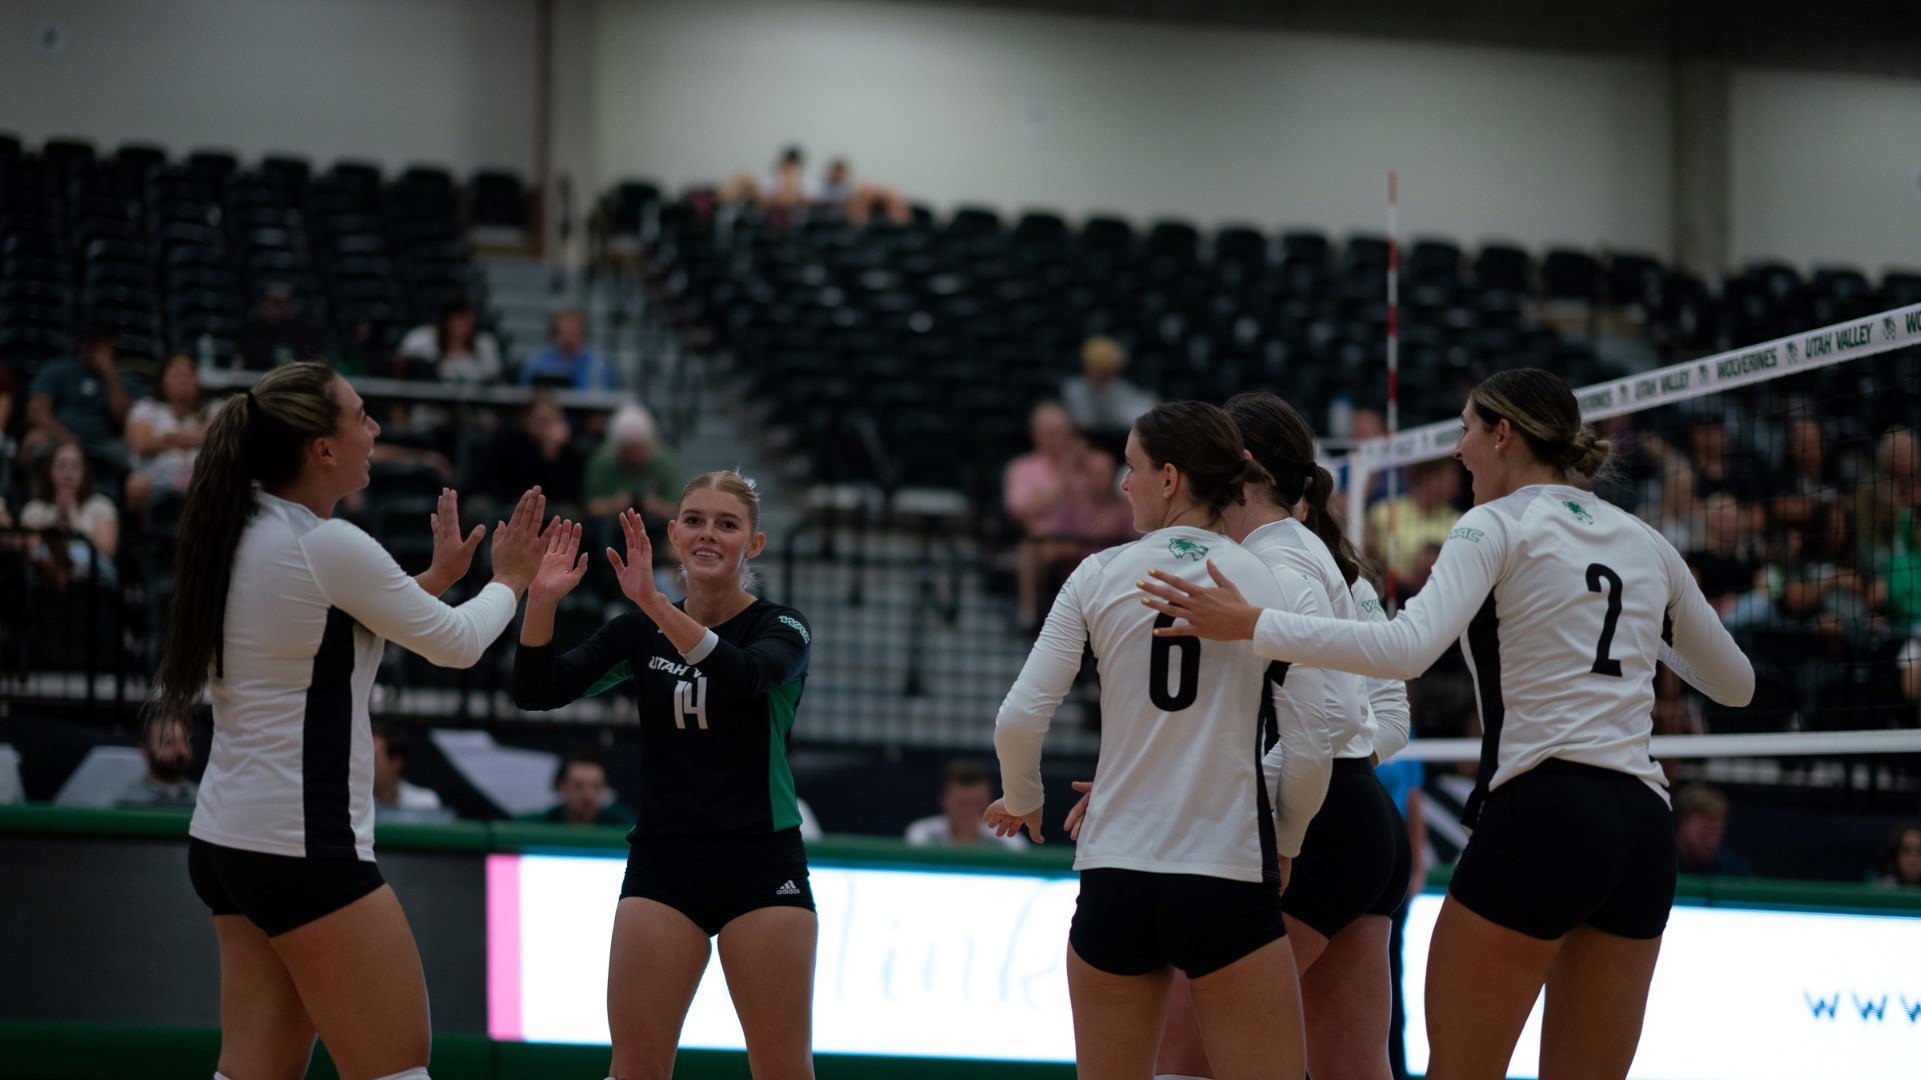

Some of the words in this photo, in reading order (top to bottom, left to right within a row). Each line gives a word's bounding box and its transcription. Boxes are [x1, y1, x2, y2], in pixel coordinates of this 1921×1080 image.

[1716, 349, 1777, 379] WOLVERINES
[1805, 332, 1832, 358] UTAH
[1836, 322, 1873, 350] VALLEY
[777, 615, 811, 645] WAC
[1585, 562, 1623, 677] 2
[648, 655, 691, 677] UTAH
[1149, 600, 1201, 712] 6
[673, 676, 709, 730] 14
